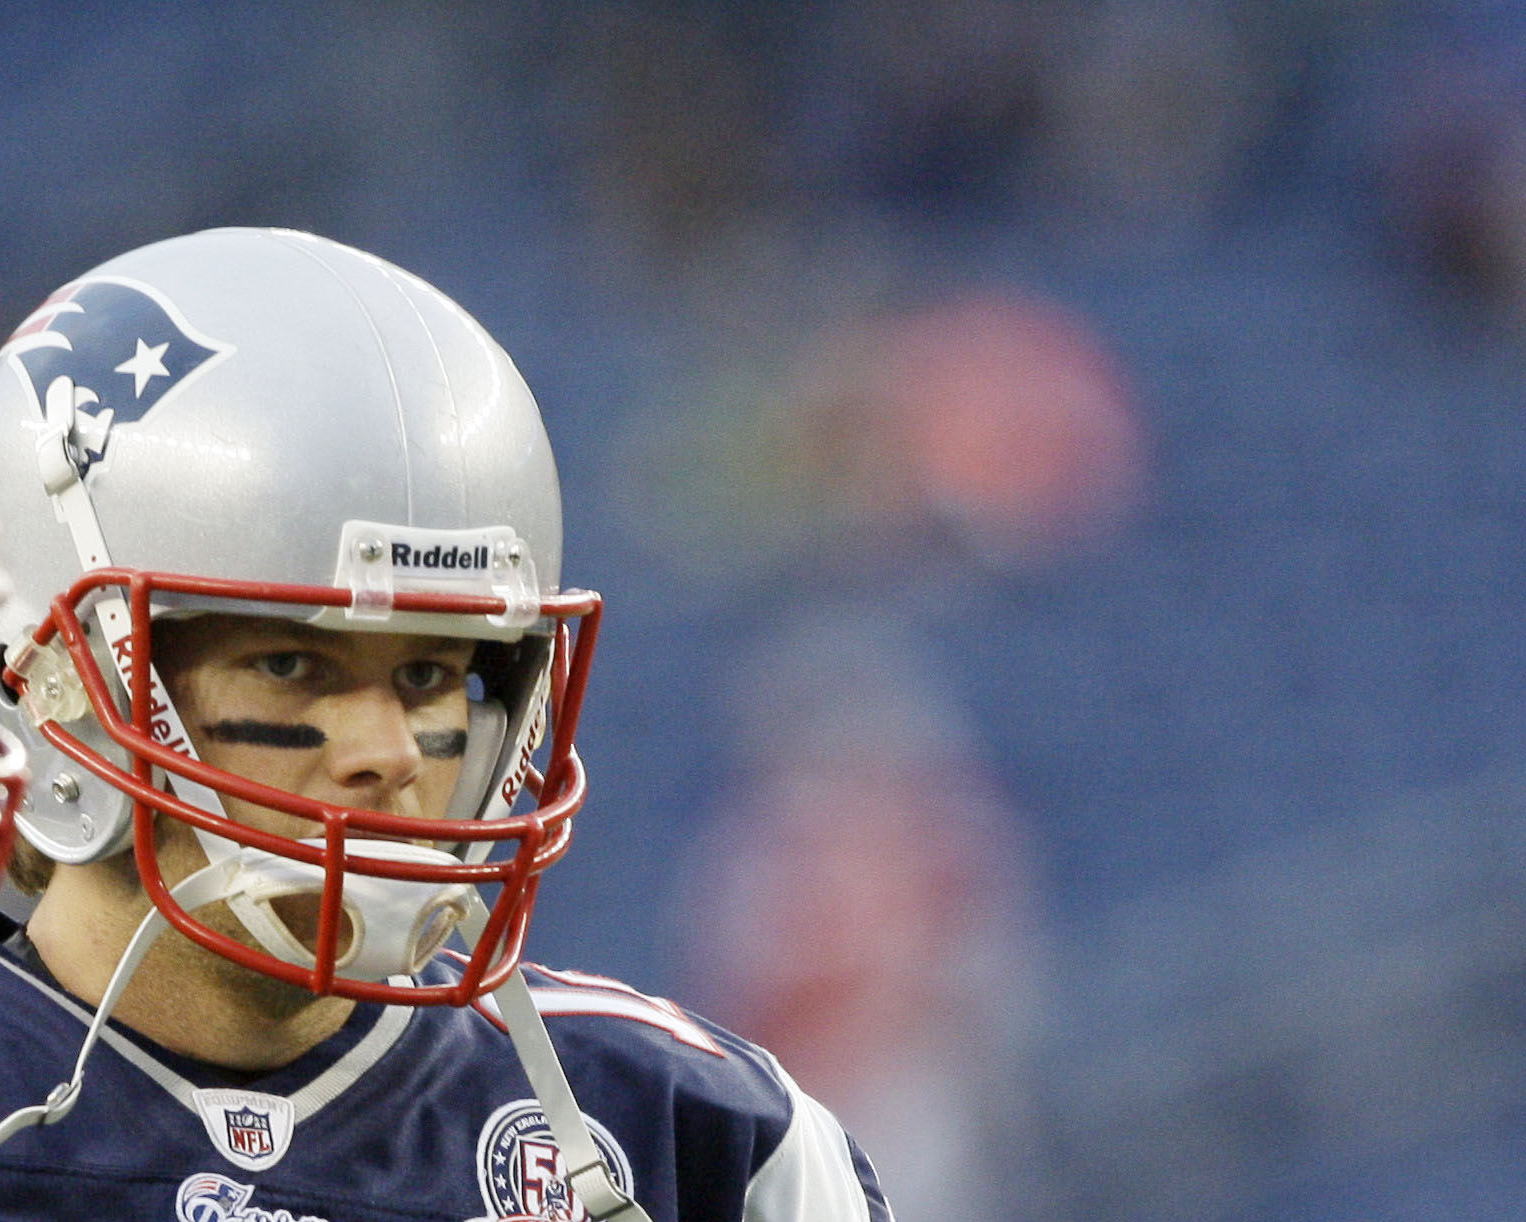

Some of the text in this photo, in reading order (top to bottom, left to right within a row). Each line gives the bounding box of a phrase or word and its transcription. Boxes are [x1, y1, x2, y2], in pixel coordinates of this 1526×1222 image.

[391, 543, 488, 570] Riddell
[231, 1126, 272, 1154] NFL
[500, 1114, 549, 1149] NEW ENGLA
